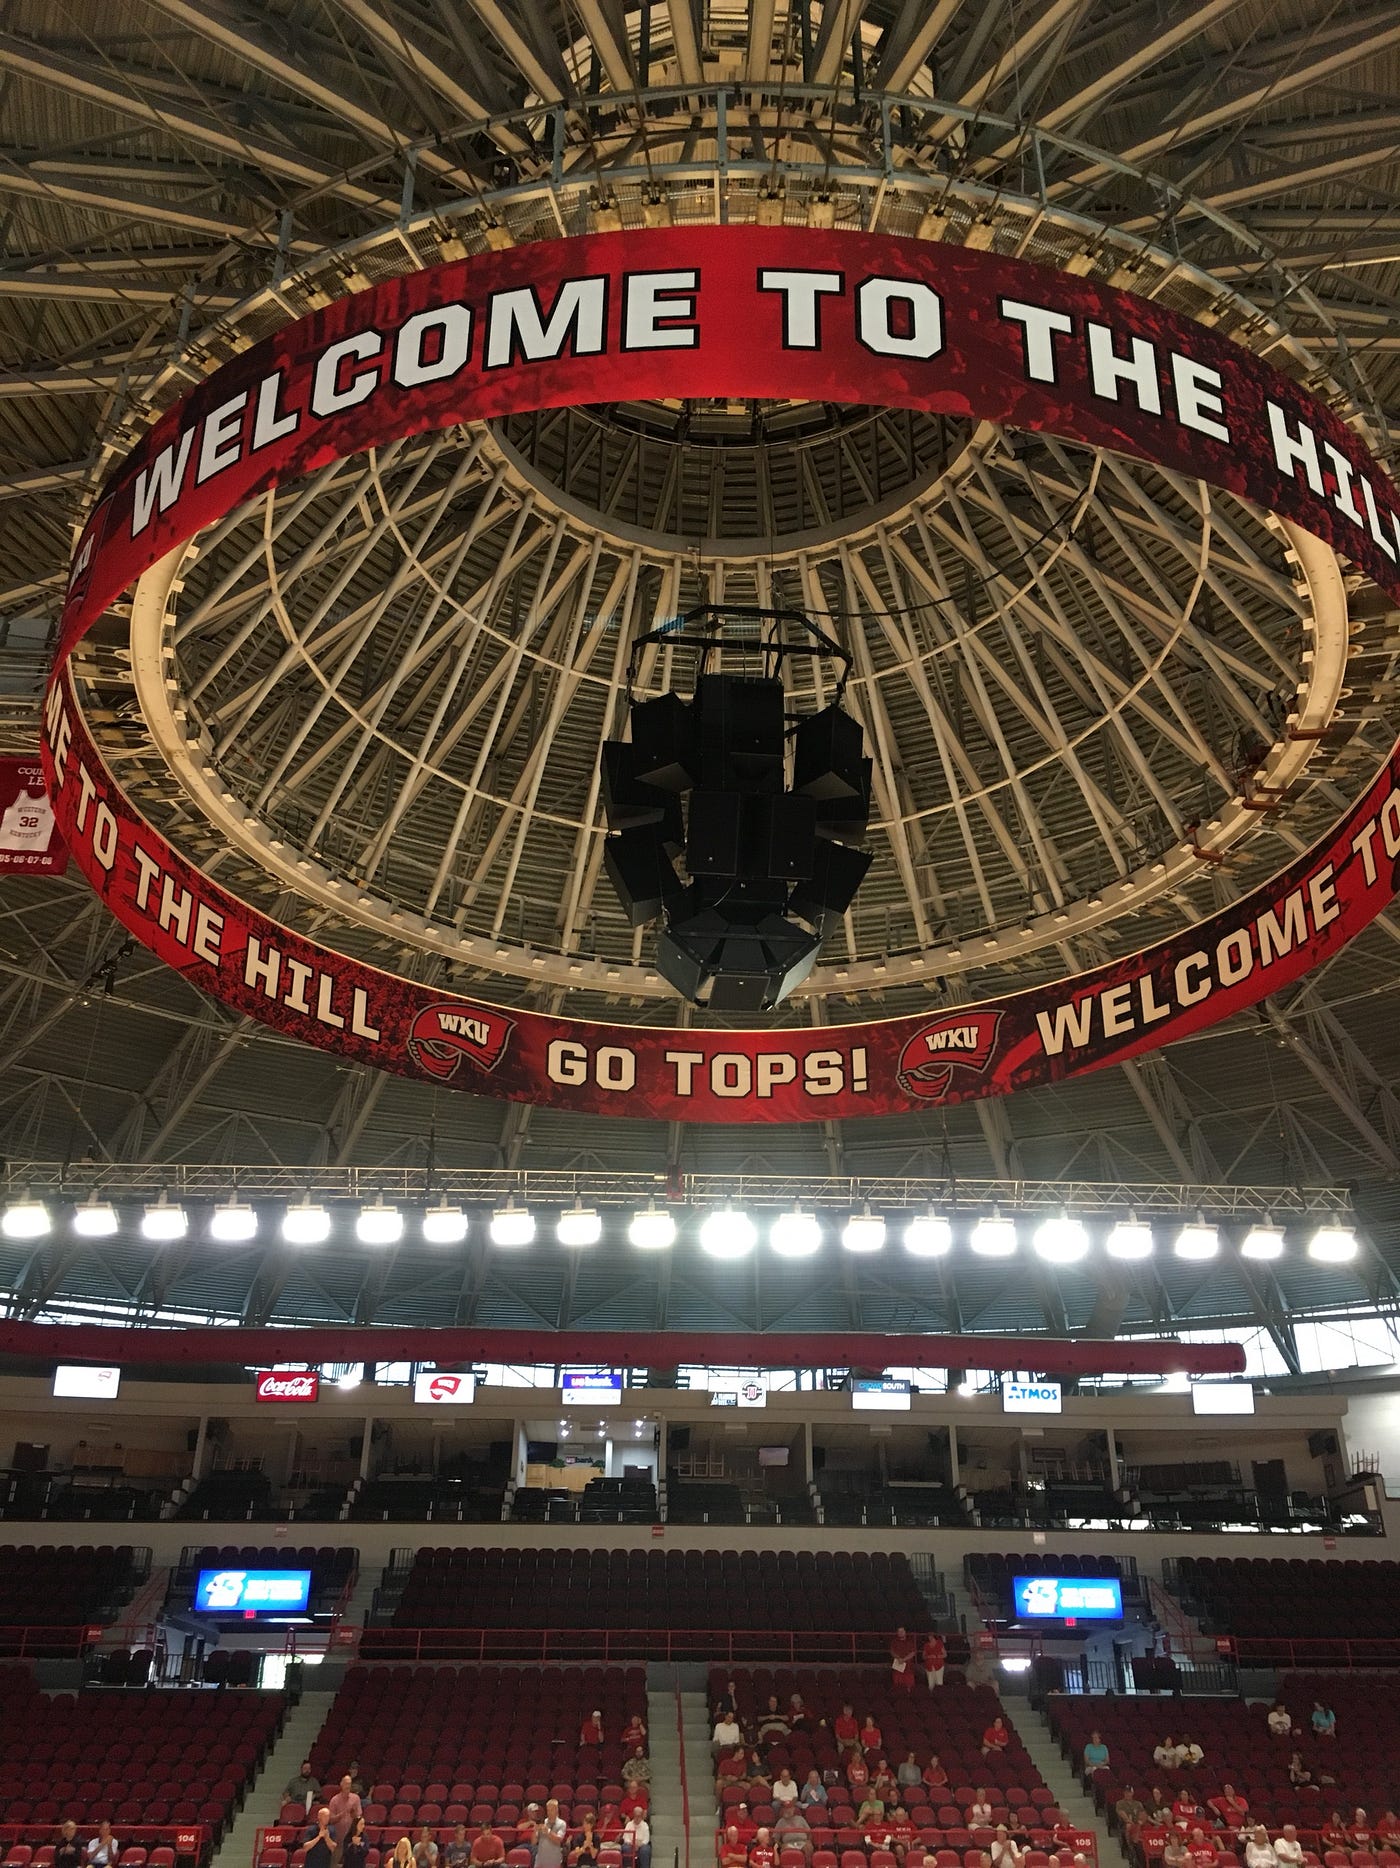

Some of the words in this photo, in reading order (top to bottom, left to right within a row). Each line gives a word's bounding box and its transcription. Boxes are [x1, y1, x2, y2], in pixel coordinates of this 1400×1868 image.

[130, 271, 697, 536] WELCOME
[757, 270, 945, 361] TO
[1000, 298, 1230, 445] THE
[19, 816, 39, 828] 32
[76, 760, 119, 872] TO
[133, 844, 225, 967] THE
[243, 935, 381, 1042] HILL
[1036, 860, 1342, 1056] WELCOME
[437, 1013, 491, 1047] WKU
[925, 1024, 979, 1053] WKU
[546, 1040, 636, 1092] GO
[664, 1047, 868, 1100] TOPS!
[1075, 1839, 1091, 1847] 105
[1148, 1839, 1164, 1847] 106
